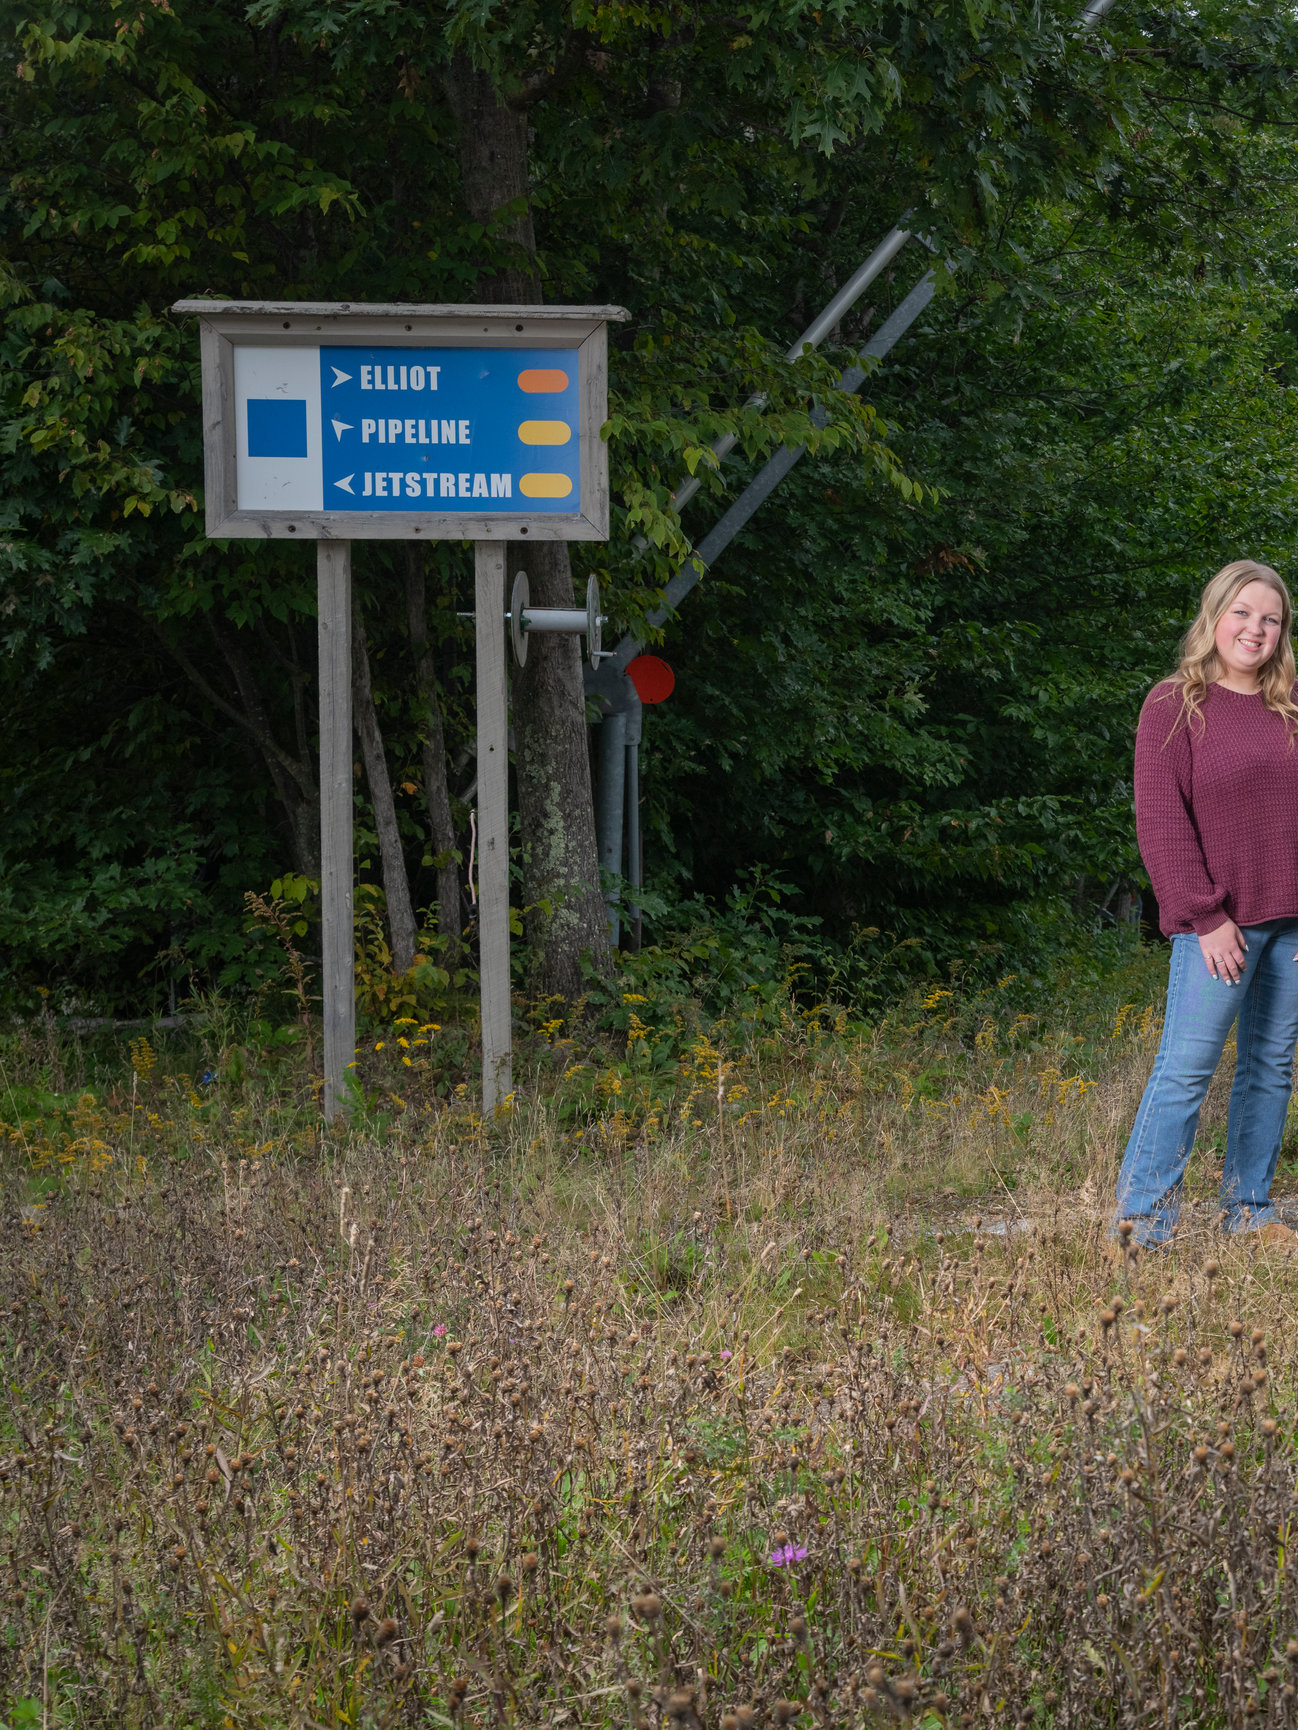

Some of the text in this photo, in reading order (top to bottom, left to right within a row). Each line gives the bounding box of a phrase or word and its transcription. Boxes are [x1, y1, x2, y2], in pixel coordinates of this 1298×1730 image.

[360, 365, 441, 391] ELLIOT
[361, 418, 471, 444] PIPELINE
[362, 472, 512, 498] JETSTREAM
